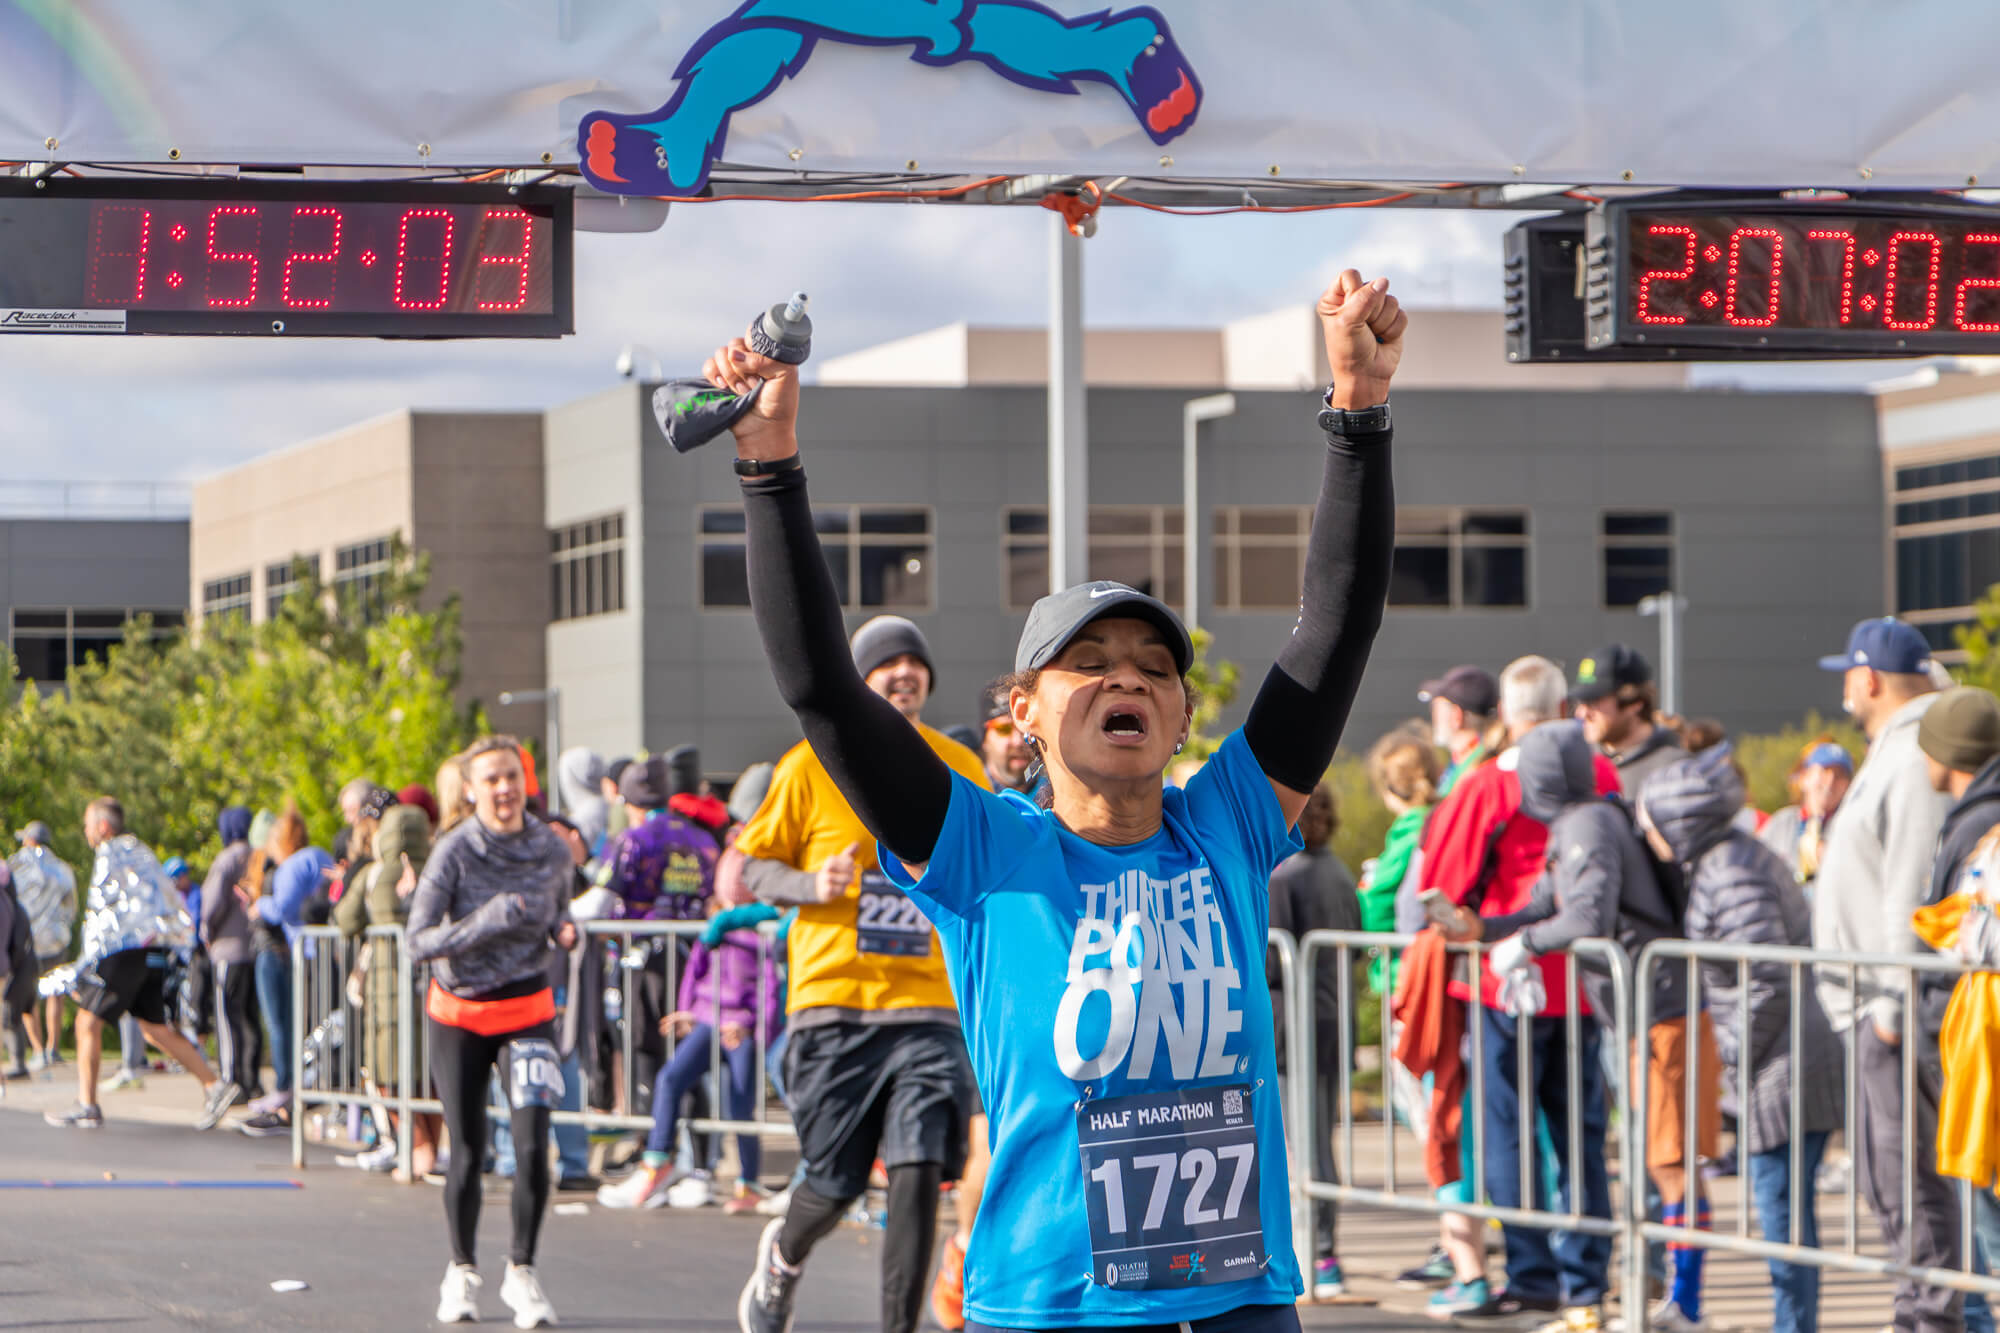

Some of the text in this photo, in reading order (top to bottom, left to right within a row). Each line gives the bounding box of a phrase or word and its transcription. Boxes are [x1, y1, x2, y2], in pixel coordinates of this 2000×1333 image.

[1639, 226, 2000, 330] 2:07:02
[2, 311, 77, 322] Raceclock
[1053, 967, 1243, 1081] ONE
[1090, 1101, 1214, 1131] HALF MARATHON
[1091, 1143, 1255, 1234] 1727
[1224, 1254, 1256, 1267] GARMIN
